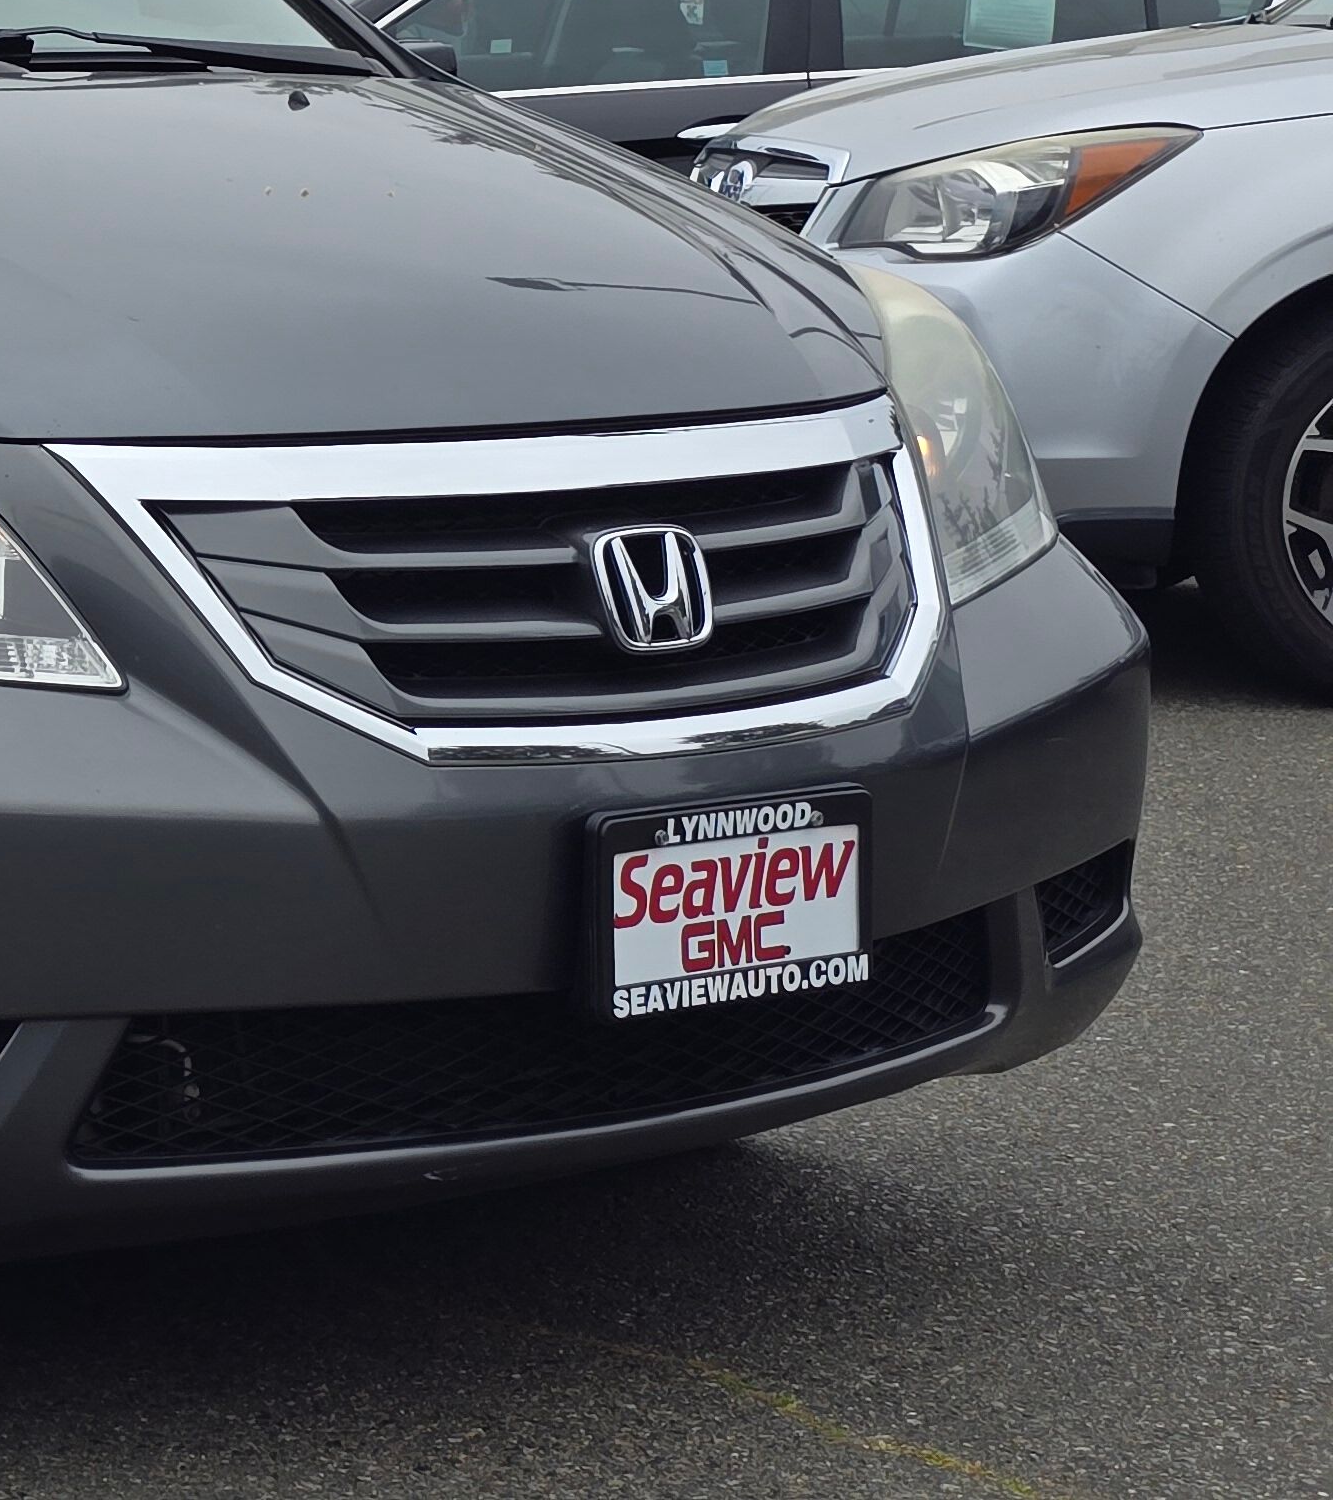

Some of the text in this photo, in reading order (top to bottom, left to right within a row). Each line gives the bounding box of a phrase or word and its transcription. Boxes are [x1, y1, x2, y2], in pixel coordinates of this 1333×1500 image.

[667, 801, 812, 844] LYNNWOOD
[613, 836, 856, 929] Seaview
[681, 910, 792, 973] GMC
[612, 954, 870, 1019] SEAVIEWAUTO.COM
